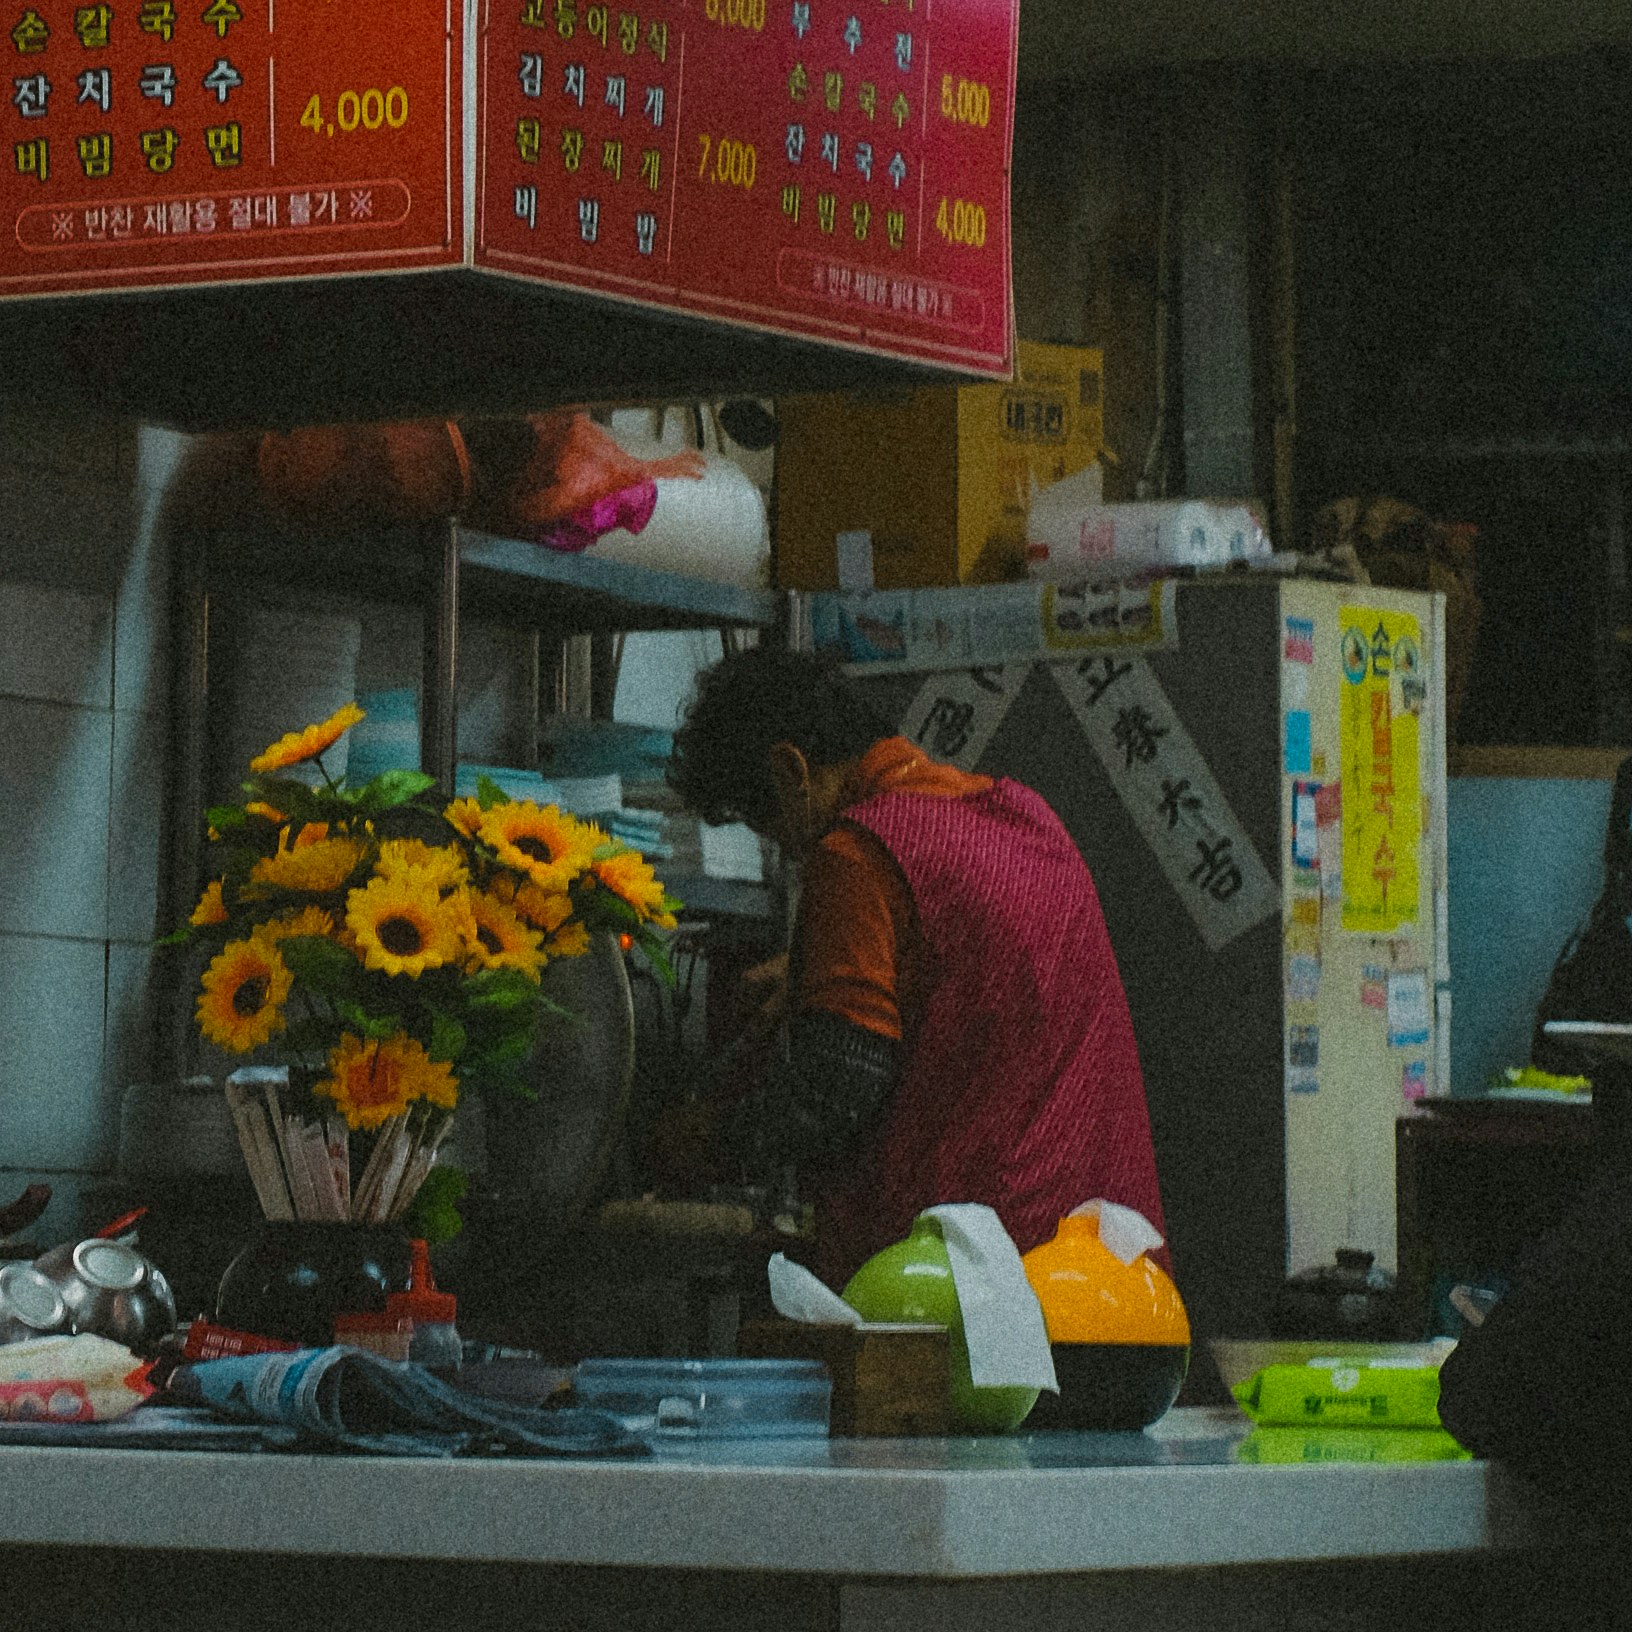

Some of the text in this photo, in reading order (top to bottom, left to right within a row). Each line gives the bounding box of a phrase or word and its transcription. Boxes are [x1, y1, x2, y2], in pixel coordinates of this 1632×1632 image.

[13, 59, 242, 118] 잔치국수
[300, 87, 409, 136] 4,000
[941, 72, 990, 128] 5,000
[14, 124, 241, 182] 비빔당면
[698, 134, 757, 189] 7,000
[84, 191, 338, 240] 반찬 재활용 절대 불가
[937, 197, 988, 248] 4,000
